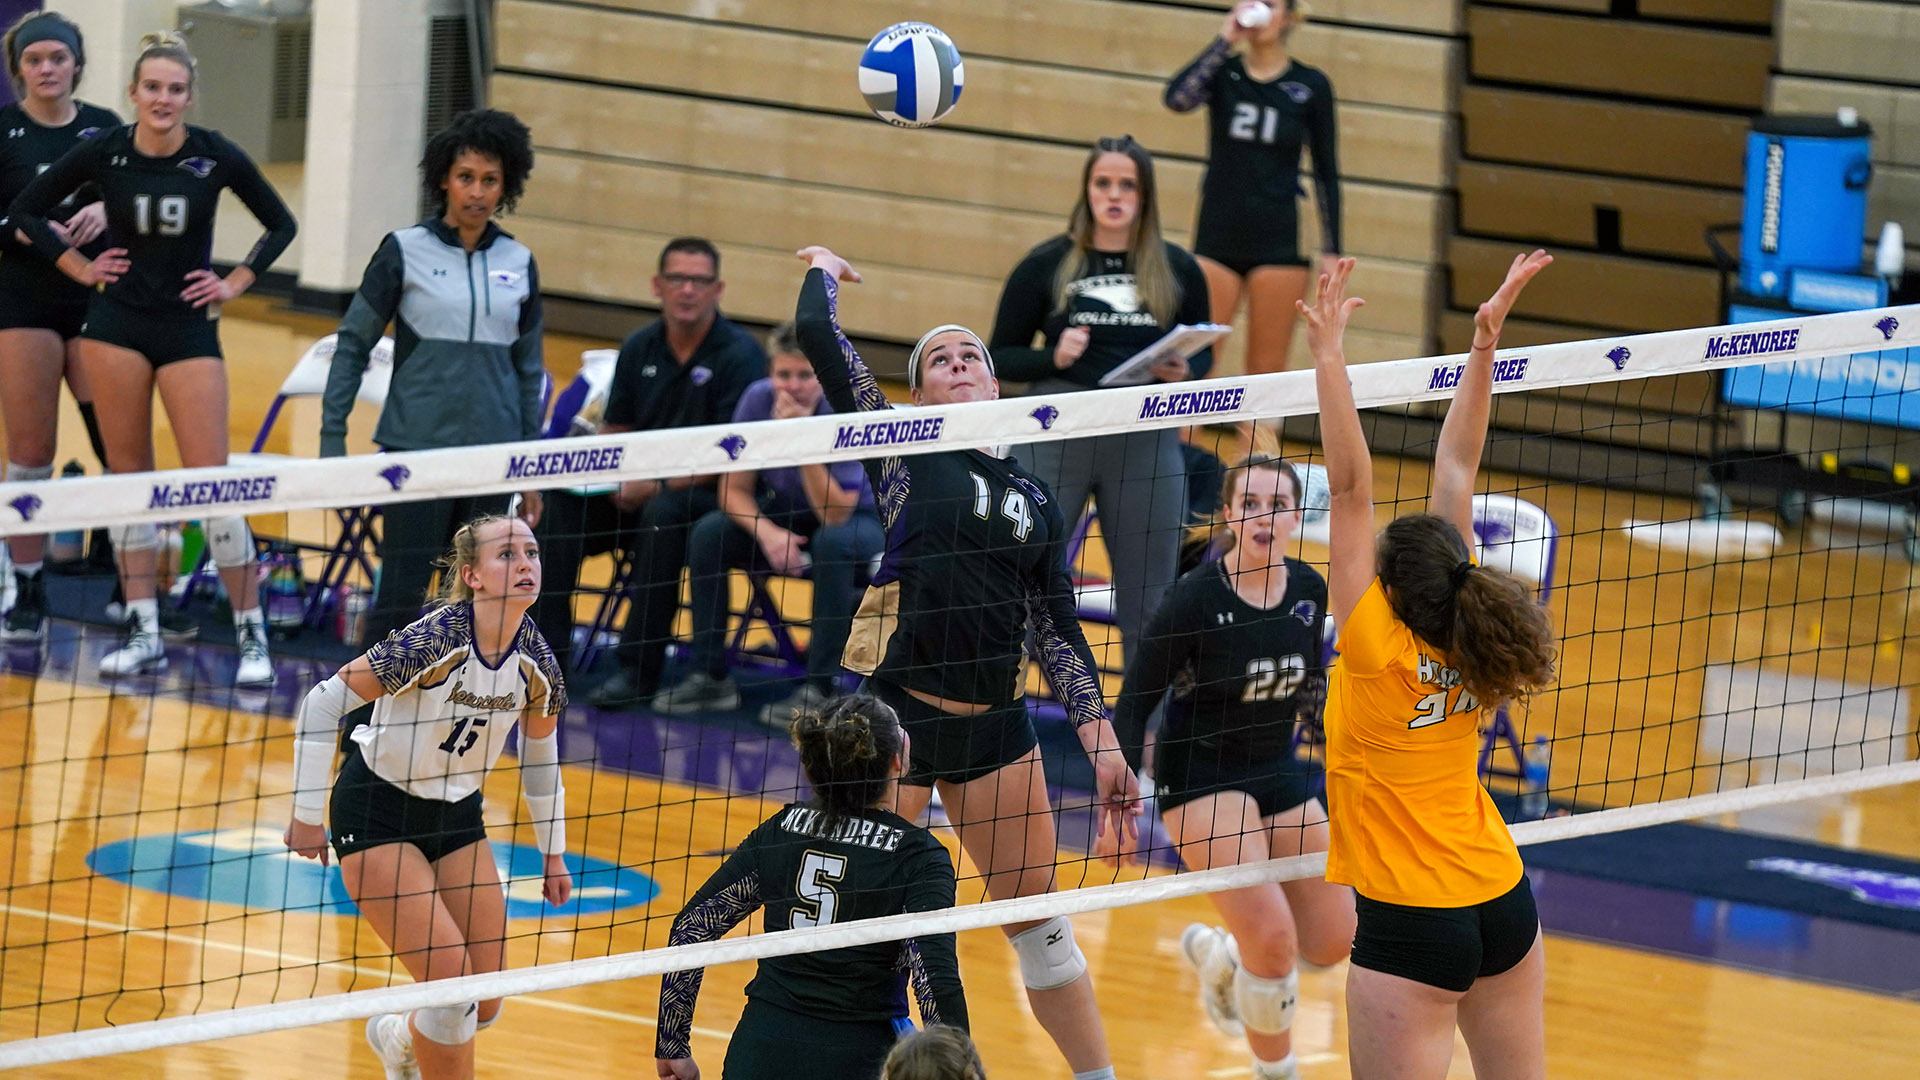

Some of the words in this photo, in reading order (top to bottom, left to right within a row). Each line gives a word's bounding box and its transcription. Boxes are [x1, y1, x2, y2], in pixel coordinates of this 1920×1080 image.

[1229, 102, 1279, 143] 21
[133, 194, 189, 237] 19
[1705, 329, 1800, 359] McKENDREE
[1429, 358, 1529, 389] McKREE
[1140, 388, 1245, 419] McKENDREE
[834, 417, 945, 449] McKENDREE
[506, 447, 624, 479] McKENDREE
[148, 476, 277, 509] McKENDREE
[969, 470, 1033, 542] 14
[1241, 653, 1306, 704] 22
[438, 717, 488, 757] 15
[789, 849, 848, 930] 5
